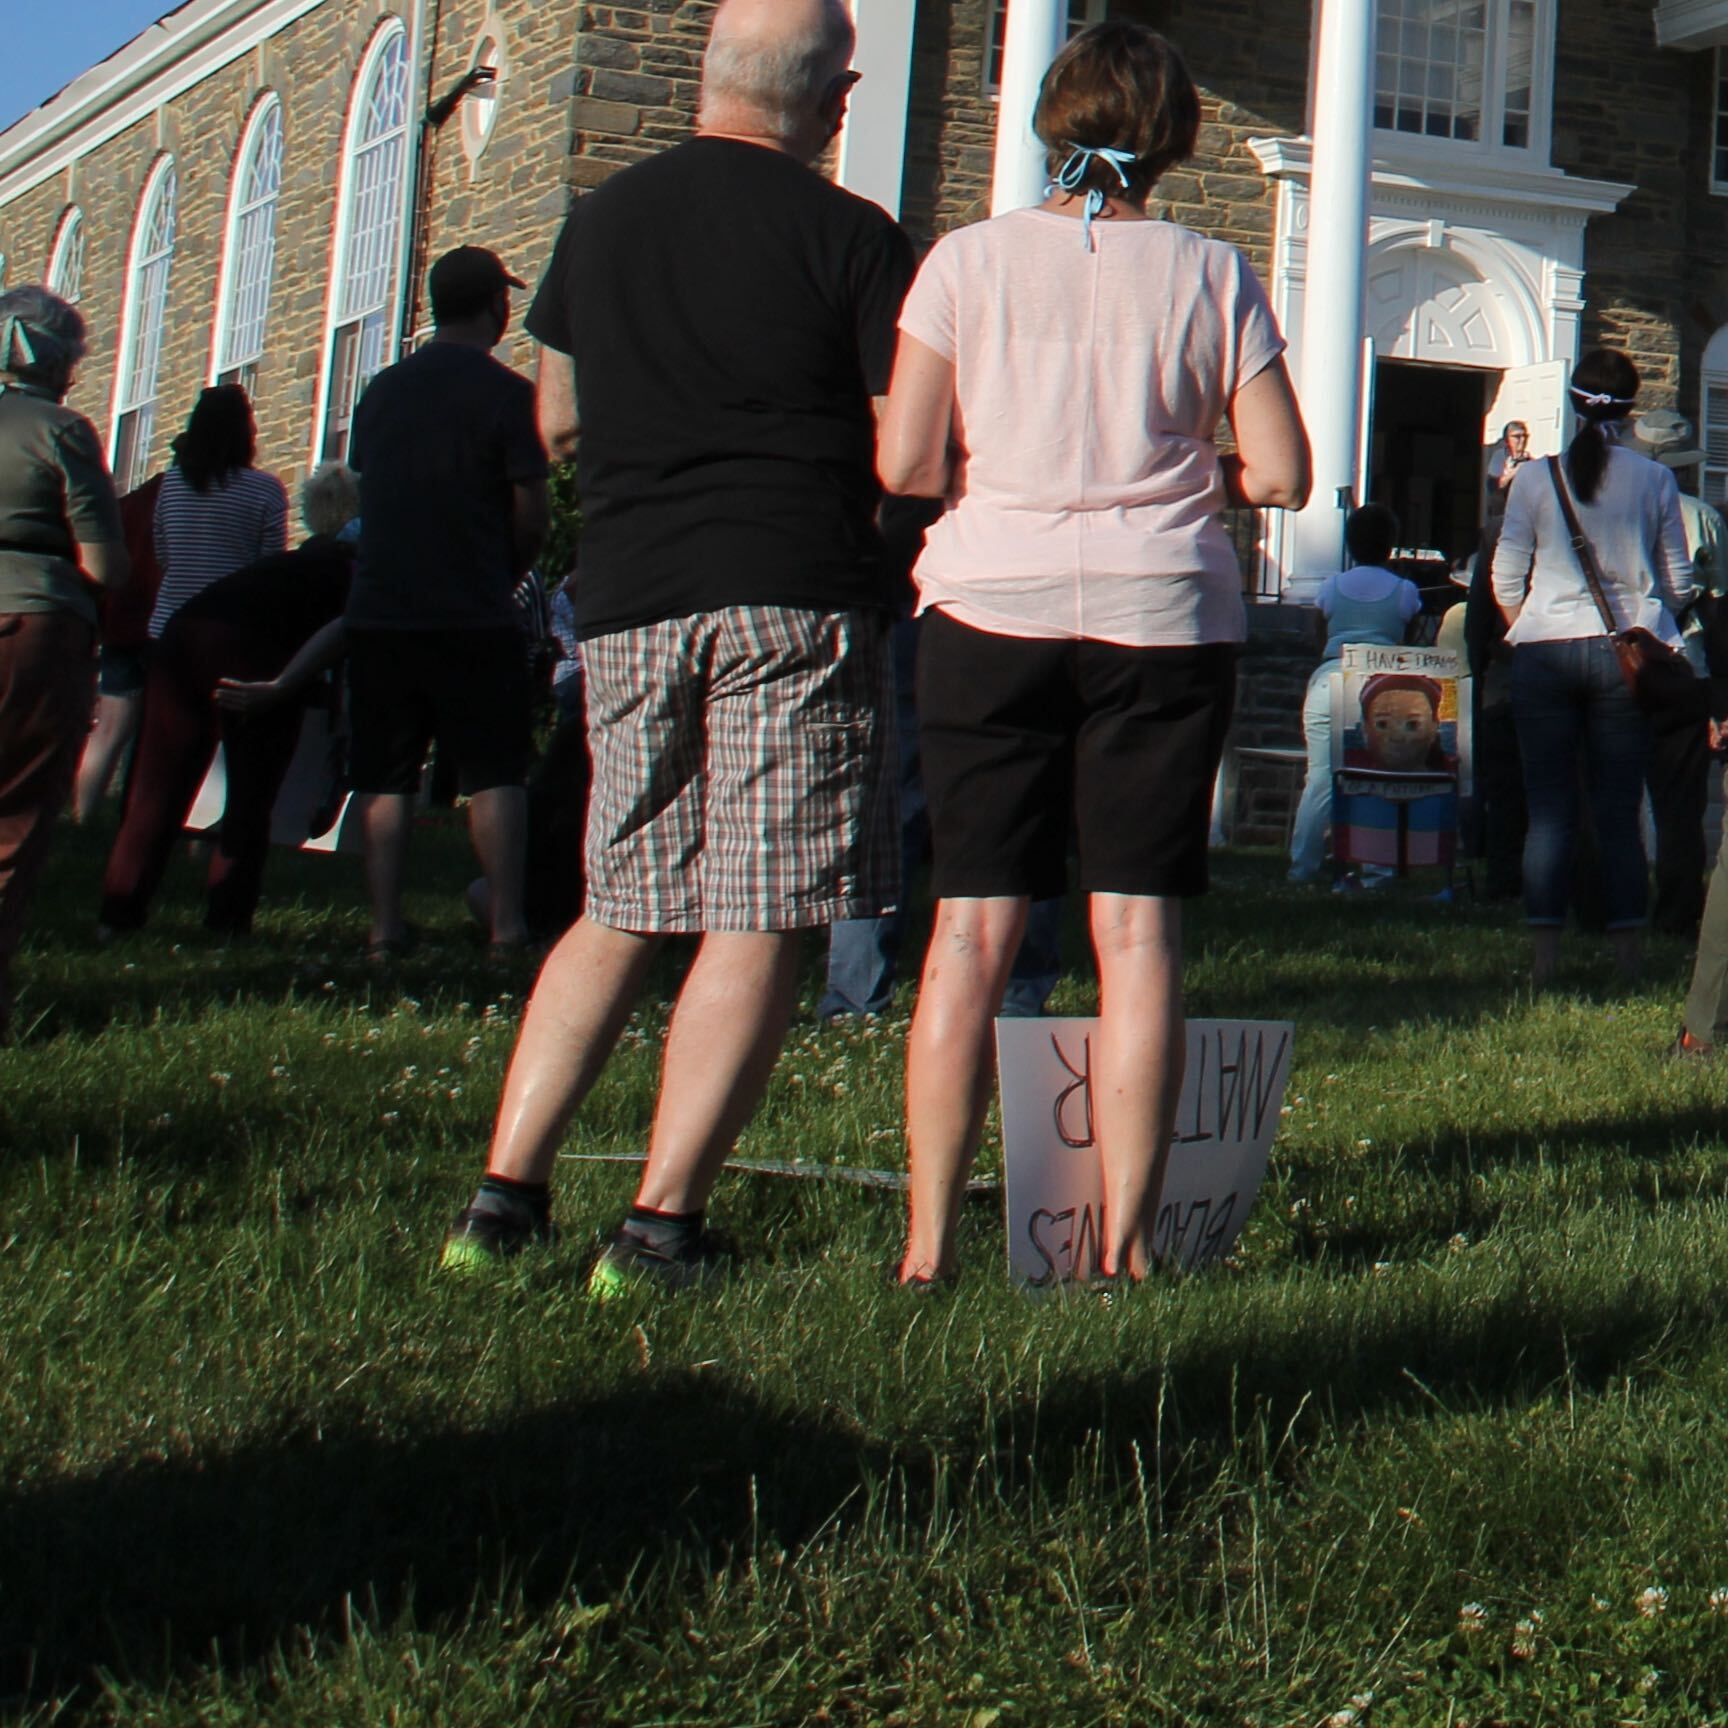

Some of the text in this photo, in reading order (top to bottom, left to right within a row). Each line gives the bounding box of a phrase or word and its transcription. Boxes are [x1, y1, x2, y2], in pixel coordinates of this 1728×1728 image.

[1344, 648, 1358, 668] I
[1366, 650, 1412, 671] HAVE
[1050, 1027, 1289, 1148] MATR
[1028, 1191, 1239, 1286] BLAC IVES
